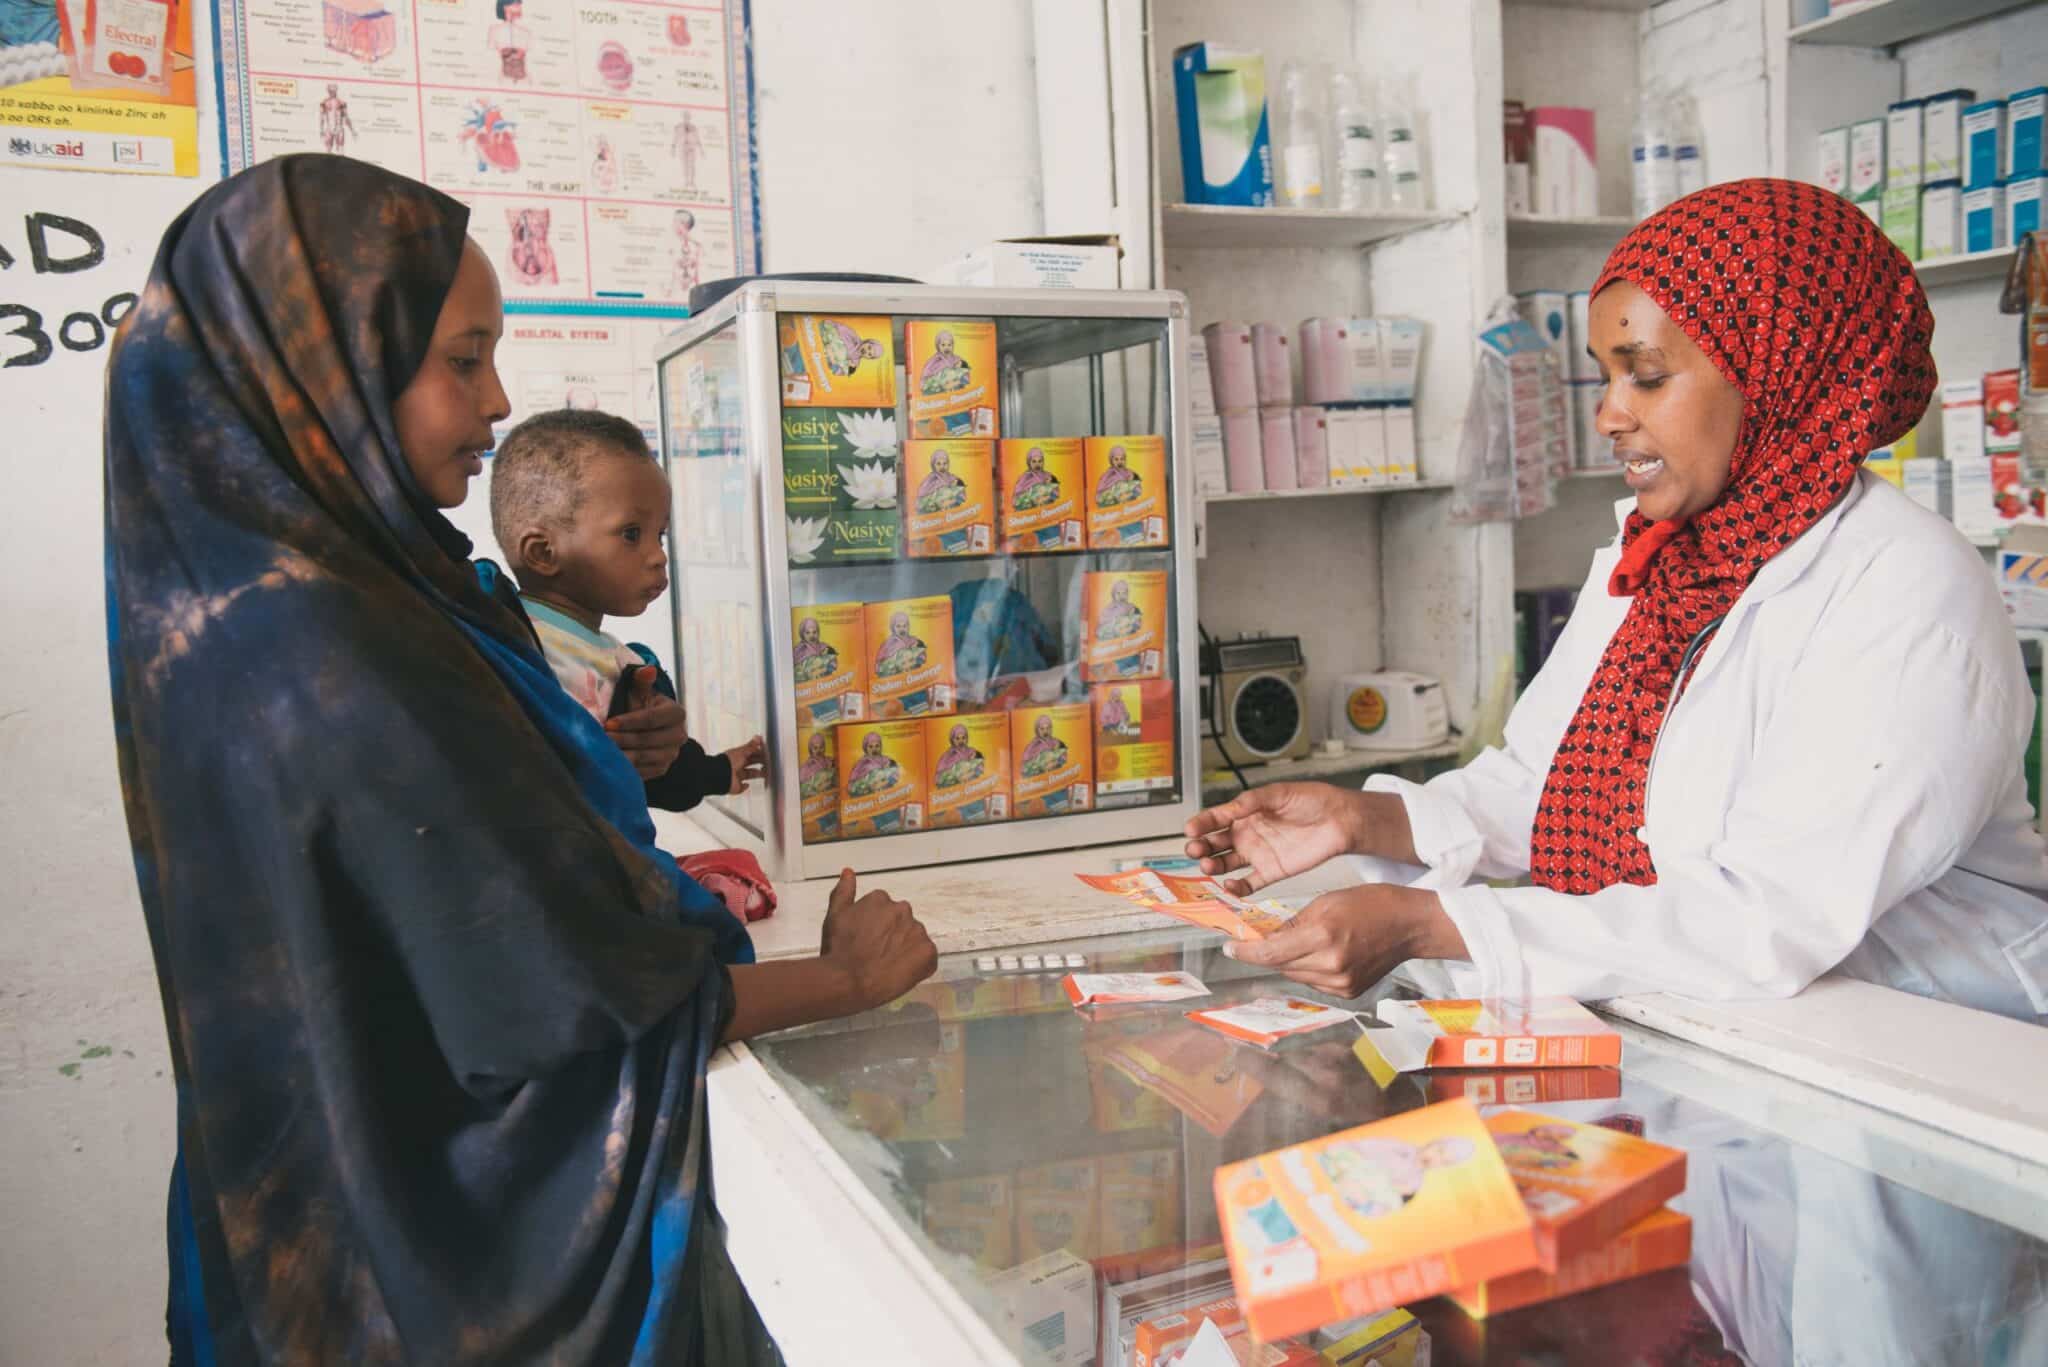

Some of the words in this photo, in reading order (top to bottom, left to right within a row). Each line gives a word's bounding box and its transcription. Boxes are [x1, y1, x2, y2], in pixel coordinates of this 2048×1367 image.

[105, 24, 157, 48] Electral
[514, 328, 564, 340] SKELETAL
[570, 329, 609, 341] SYSTEM
[834, 519, 895, 546] Nasiye
